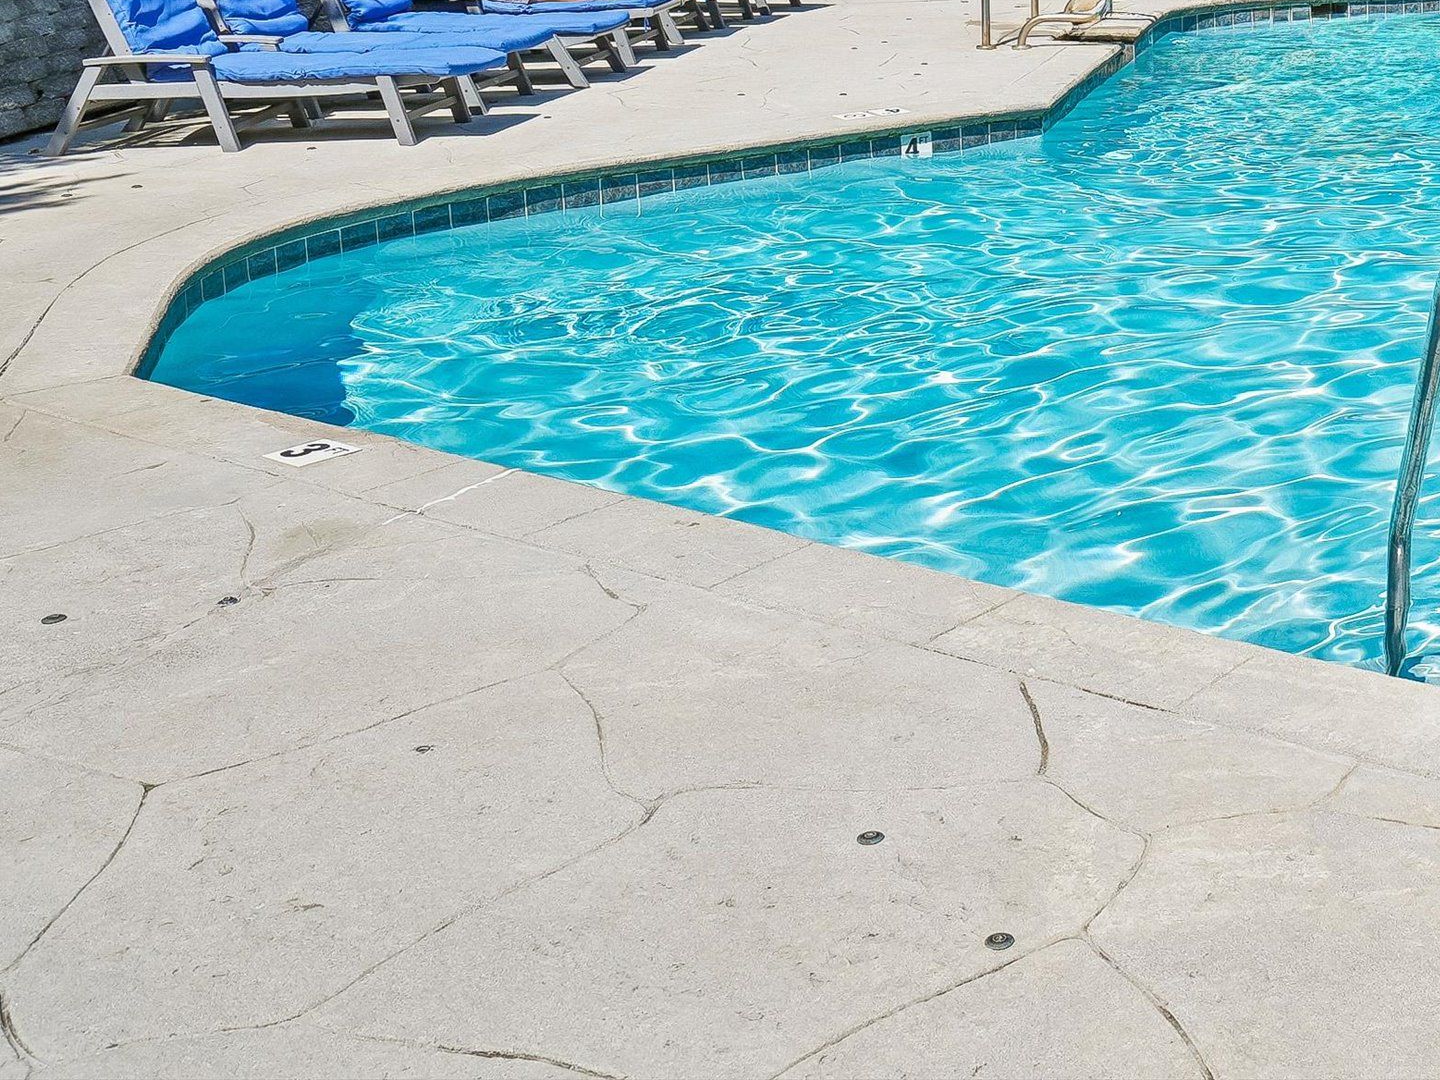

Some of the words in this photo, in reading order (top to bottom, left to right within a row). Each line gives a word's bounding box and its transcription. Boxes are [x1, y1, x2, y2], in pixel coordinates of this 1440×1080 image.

[905, 137, 919, 154] 4
[920, 135, 929, 144] FT
[280, 443, 330, 457] 3
